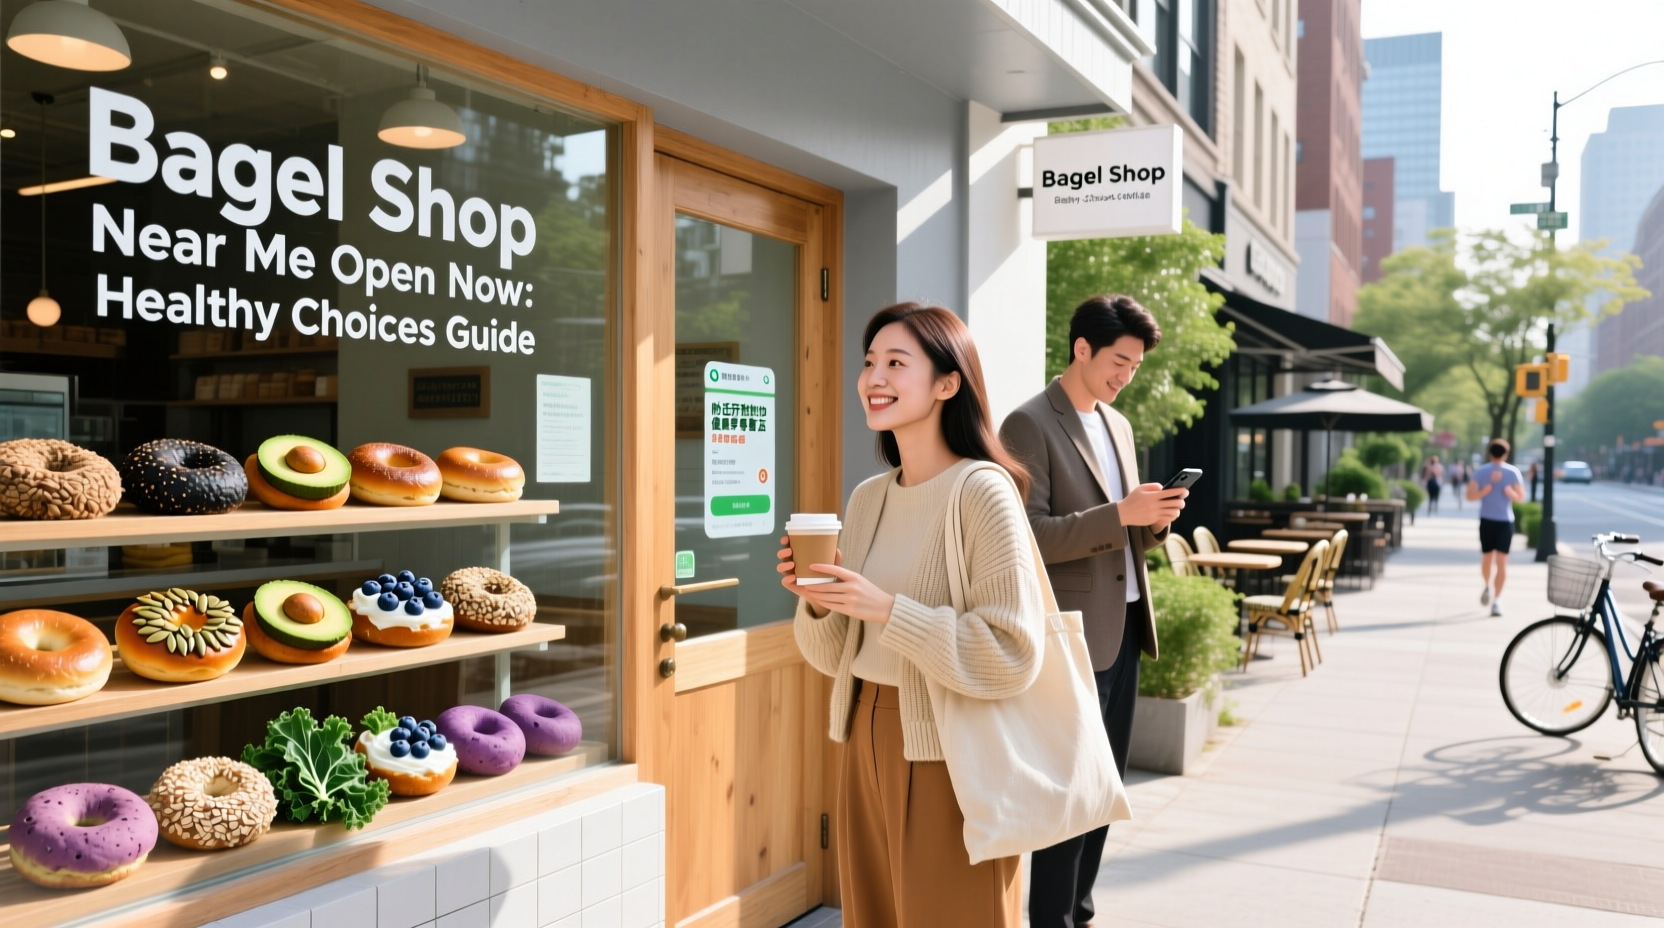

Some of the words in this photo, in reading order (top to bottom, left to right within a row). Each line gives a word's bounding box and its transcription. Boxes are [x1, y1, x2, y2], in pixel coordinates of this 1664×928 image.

[90, 86, 343, 226] Bagel
[369, 159, 537, 269] Shop
[1042, 165, 1102, 190] Bagel
[1109, 164, 1166, 185] Shop
[93, 203, 227, 266] Near
[246, 229, 315, 278] Me
[331, 245, 434, 296] Open
[450, 262, 534, 307] Now:
[97, 274, 279, 341] Healthy
[292, 298, 435, 346] Choices
[447, 316, 536, 354] Guide
